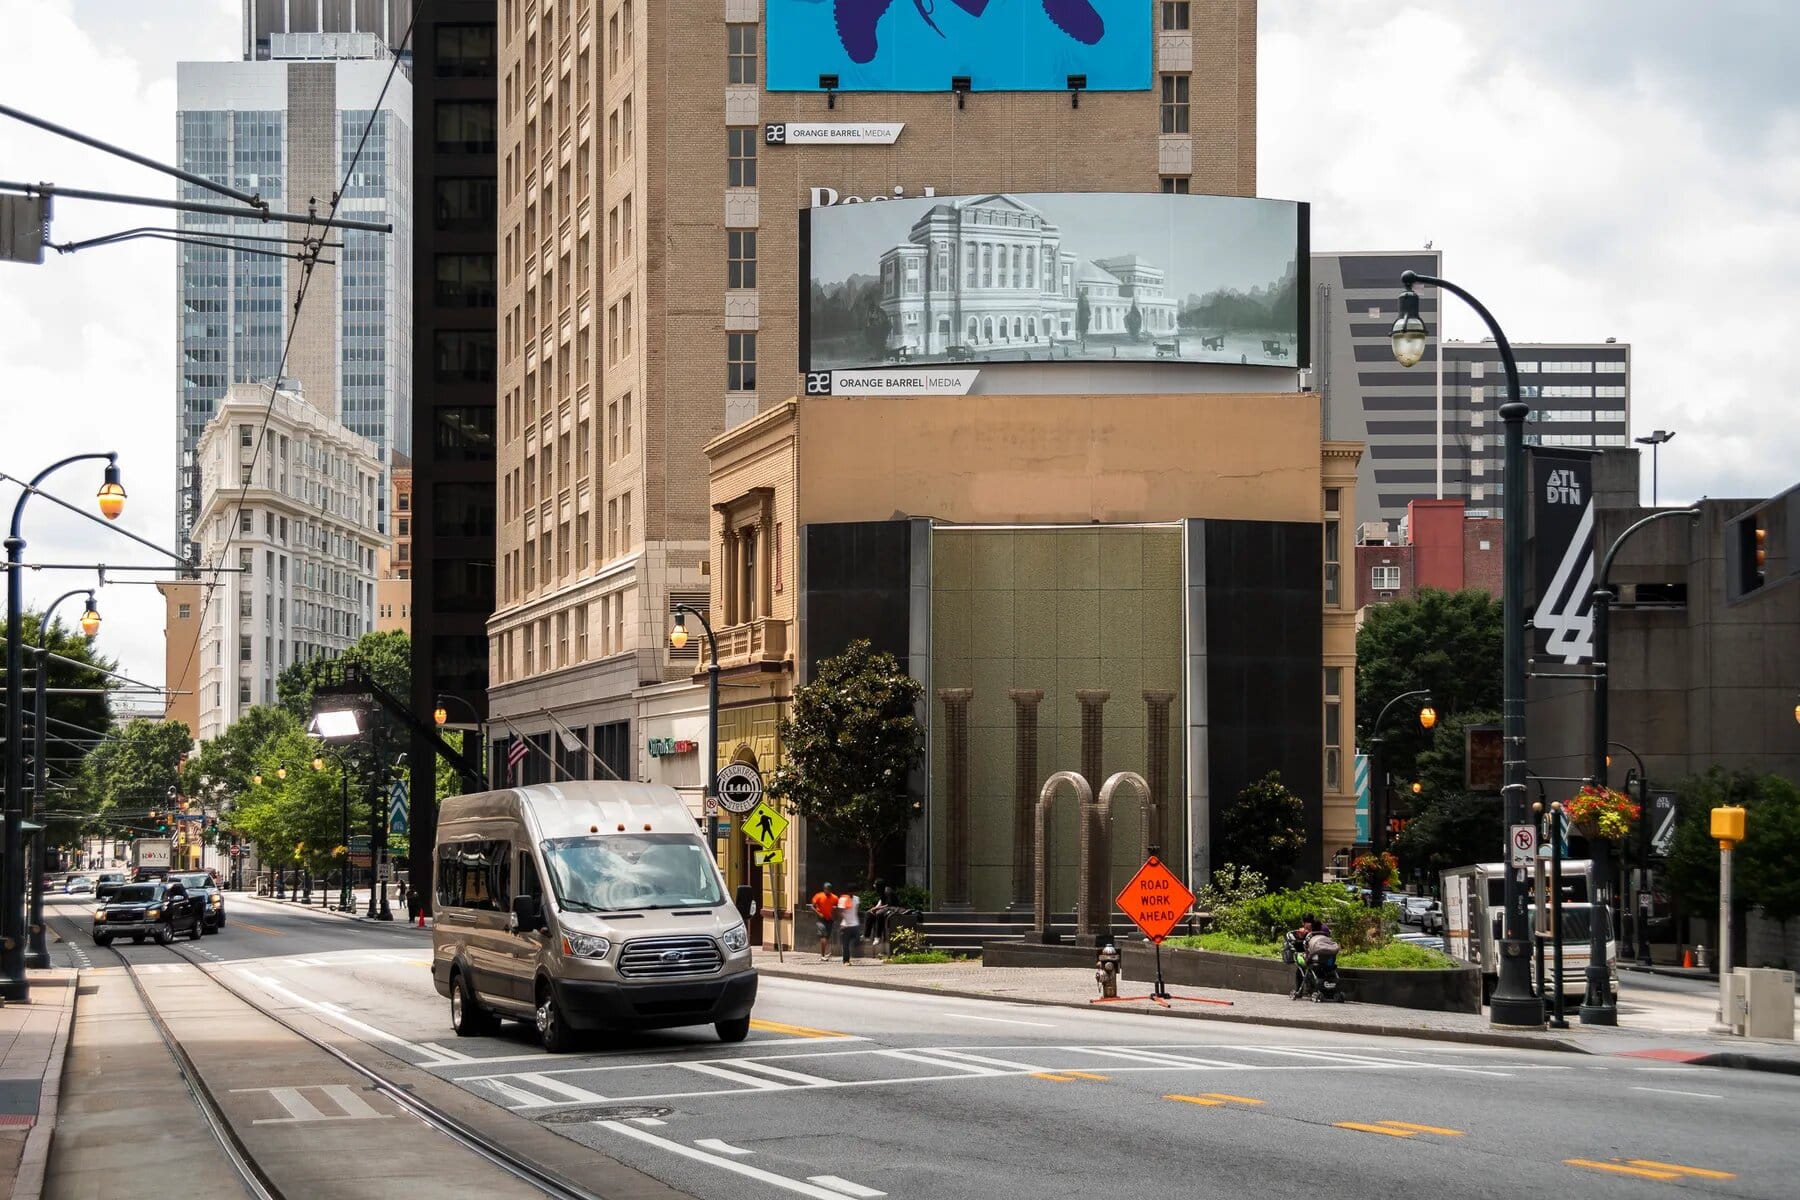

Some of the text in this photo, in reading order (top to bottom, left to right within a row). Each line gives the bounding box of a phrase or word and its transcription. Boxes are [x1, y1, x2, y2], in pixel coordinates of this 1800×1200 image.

[793, 129, 829, 138] ORANGE
[830, 129, 861, 138] BARREL
[865, 129, 892, 138] MEDIA
[839, 378, 883, 388] ORANGE
[886, 378, 924, 388] BARREL
[928, 378, 962, 388] MEDIA
[1546, 469, 1580, 488] ATL
[1546, 486, 1581, 505] DTN
[720, 764, 757, 781] PEACHTREE
[728, 783, 751, 795] 140
[727, 800, 753, 811] STREET
[141, 852, 169, 860] ROYAL
[1140, 879, 1169, 890] ROAD
[1140, 895, 1170, 906] WORK
[1139, 910, 1174, 922] AHEAD
